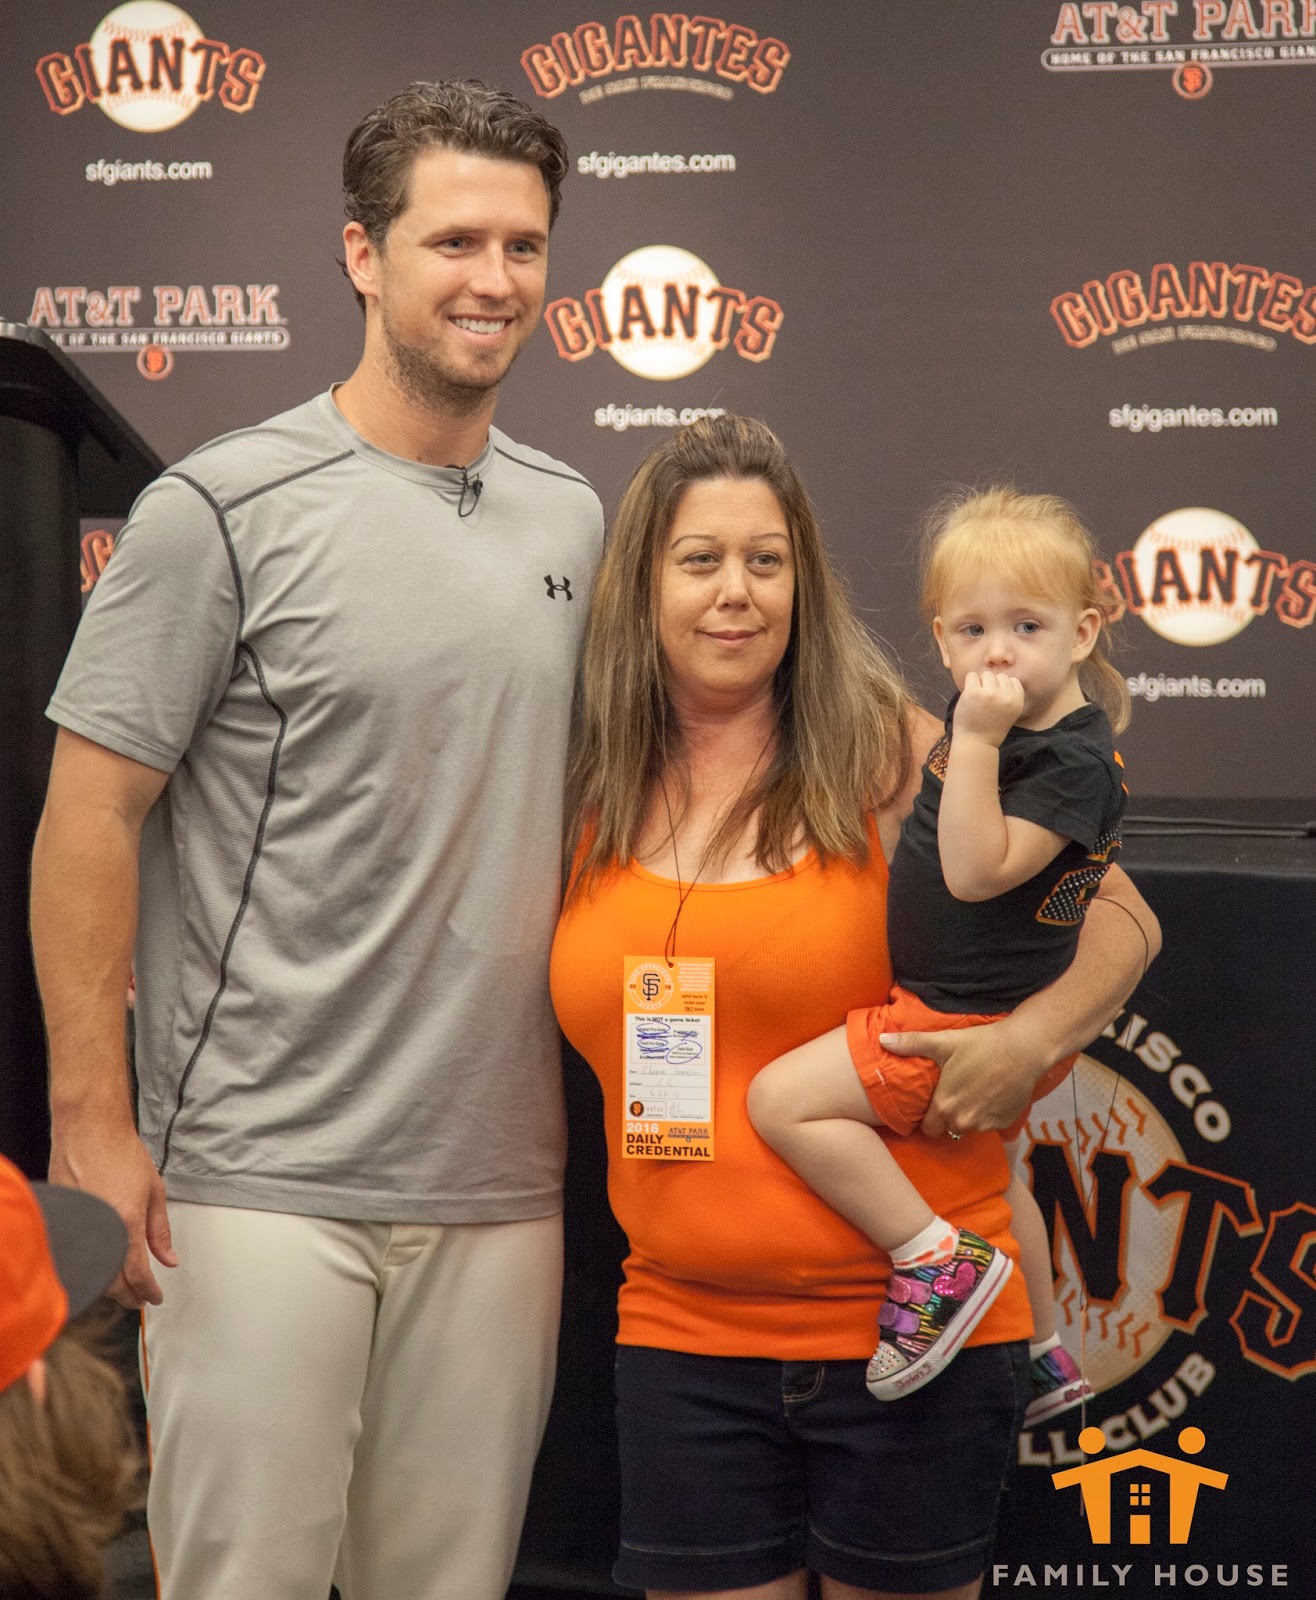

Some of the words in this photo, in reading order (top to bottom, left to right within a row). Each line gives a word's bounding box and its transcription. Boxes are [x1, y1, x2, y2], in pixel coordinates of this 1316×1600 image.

[1050, 1, 1177, 45] AT&T
[520, 13, 792, 99] GIGANTES
[1050, 52, 1093, 66] HOME
[1097, 52, 1115, 65] OF
[1120, 51, 1151, 64] THE
[1154, 49, 1186, 63] SAN
[1190, 46, 1275, 62] FRANCISCO
[36, 38, 266, 115] GIANTS
[85, 158, 213, 186] sfgiants.com
[577, 151, 737, 179] sfgigantes.com
[27, 286, 141, 327] AT&T
[153, 284, 281, 326] PARK
[121, 332, 149, 346] SAN
[153, 330, 224, 346] FRANCISCO
[230, 330, 281, 345] GIANTS
[544, 284, 784, 363] GIANTS
[1108, 403, 1278, 433] sfgigantes.com
[1126, 672, 1266, 702] sfgiants.com
[626, 1122, 659, 1134] 2016
[626, 1134, 664, 1144] DAILY
[626, 1145, 711, 1157] CREDENTIAL
